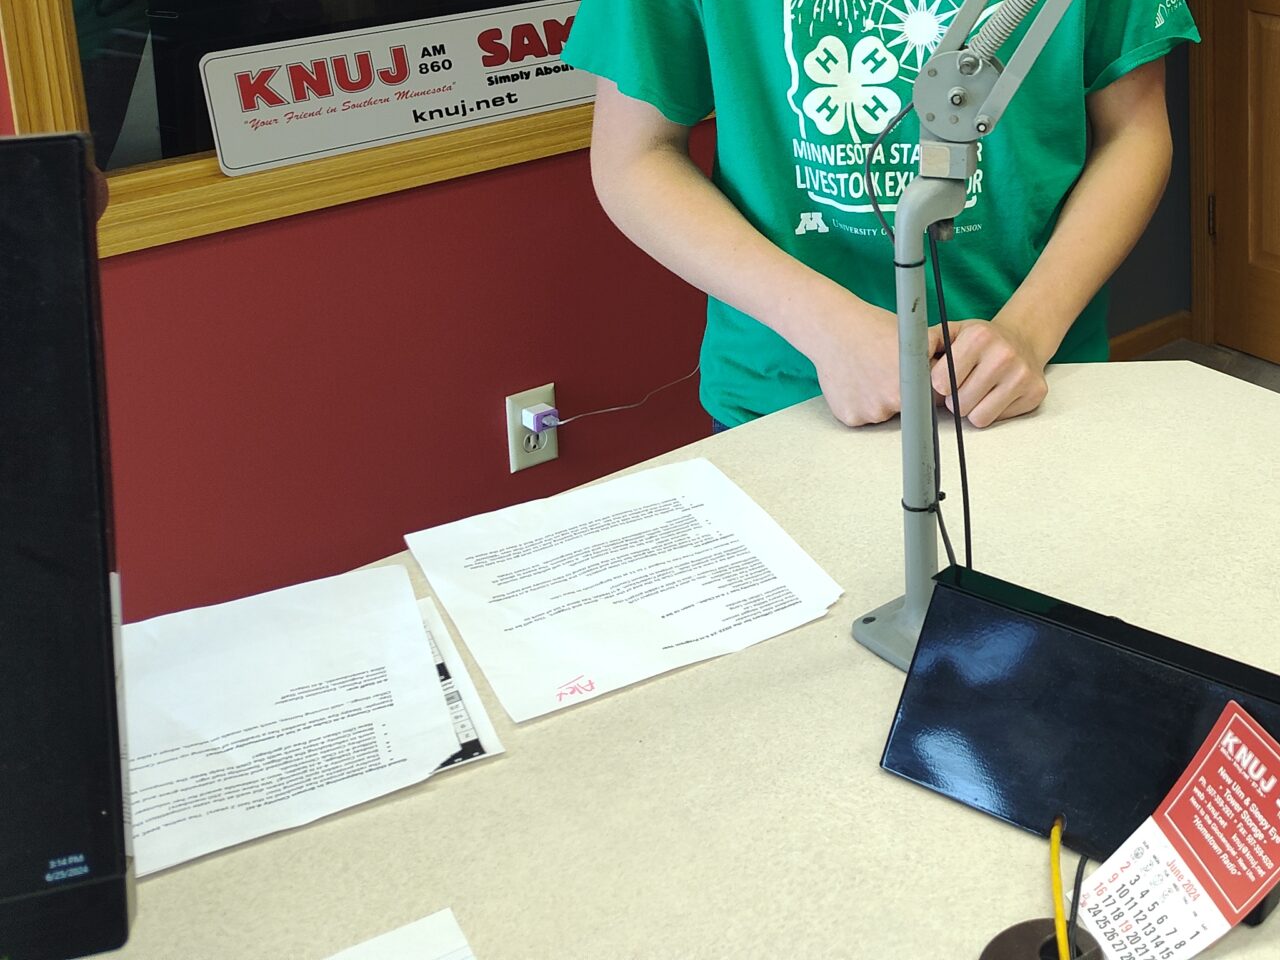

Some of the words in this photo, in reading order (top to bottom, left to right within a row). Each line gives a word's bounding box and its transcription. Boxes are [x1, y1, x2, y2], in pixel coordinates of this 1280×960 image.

[418, 59, 452, 74] 860
[420, 44, 446, 58] AM
[234, 44, 411, 112] KNUJ
[487, 70, 530, 86] Simply
[284, 107, 322, 124] Friend
[326, 106, 337, 114] in
[341, 96, 390, 112] Southern
[394, 81, 456, 100] Minnesota"
[412, 92, 518, 123] knuj.net
[793, 139, 885, 166] MINNESOTA
[832, 218, 877, 236] UNIVERSITY
[1222, 731, 1276, 792] KNUJ
[1193, 786, 1205, 800] web
[1206, 802, 1227, 828] knuj.net
[1218, 766, 1233, 784] New
[1231, 782, 1245, 799] Ulm
[1243, 797, 1250, 806] &
[1249, 803, 1270, 830] Sleepy
[1268, 827, 1280, 844] Eye
[1224, 788, 1242, 812] Tower
[1241, 810, 1264, 840] Storage
[1193, 815, 1222, 854] "Hometown
[1166, 859, 1184, 882] June
[1182, 879, 1200, 901] 2024
[1094, 882, 1107, 896] 16
[1102, 894, 1116, 907] 17
[1110, 907, 1124, 921] 18
[1118, 919, 1133, 933] 19
[1126, 931, 1142, 945] 20
[1134, 943, 1150, 956] 21
[1108, 872, 1119, 883] 9
[1116, 883, 1130, 899] 10
[1124, 897, 1138, 911] 11
[1133, 909, 1147, 924] 12
[1141, 922, 1156, 936] 13
[1150, 935, 1165, 948] 14
[1159, 947, 1174, 960] 15
[1120, 861, 1131, 873] 2
[1129, 874, 1141, 886] 3
[1139, 889, 1150, 899] 4
[1147, 901, 1159, 912] 5
[1156, 914, 1168, 925] 6
[1165, 927, 1178, 936] 7
[1174, 940, 1186, 950] 8
[1087, 903, 1103, 917] 24
[1095, 915, 1111, 929] 25
[1103, 927, 1119, 941] 26
[1111, 939, 1128, 952] 27
[1189, 930, 1200, 940] 1
